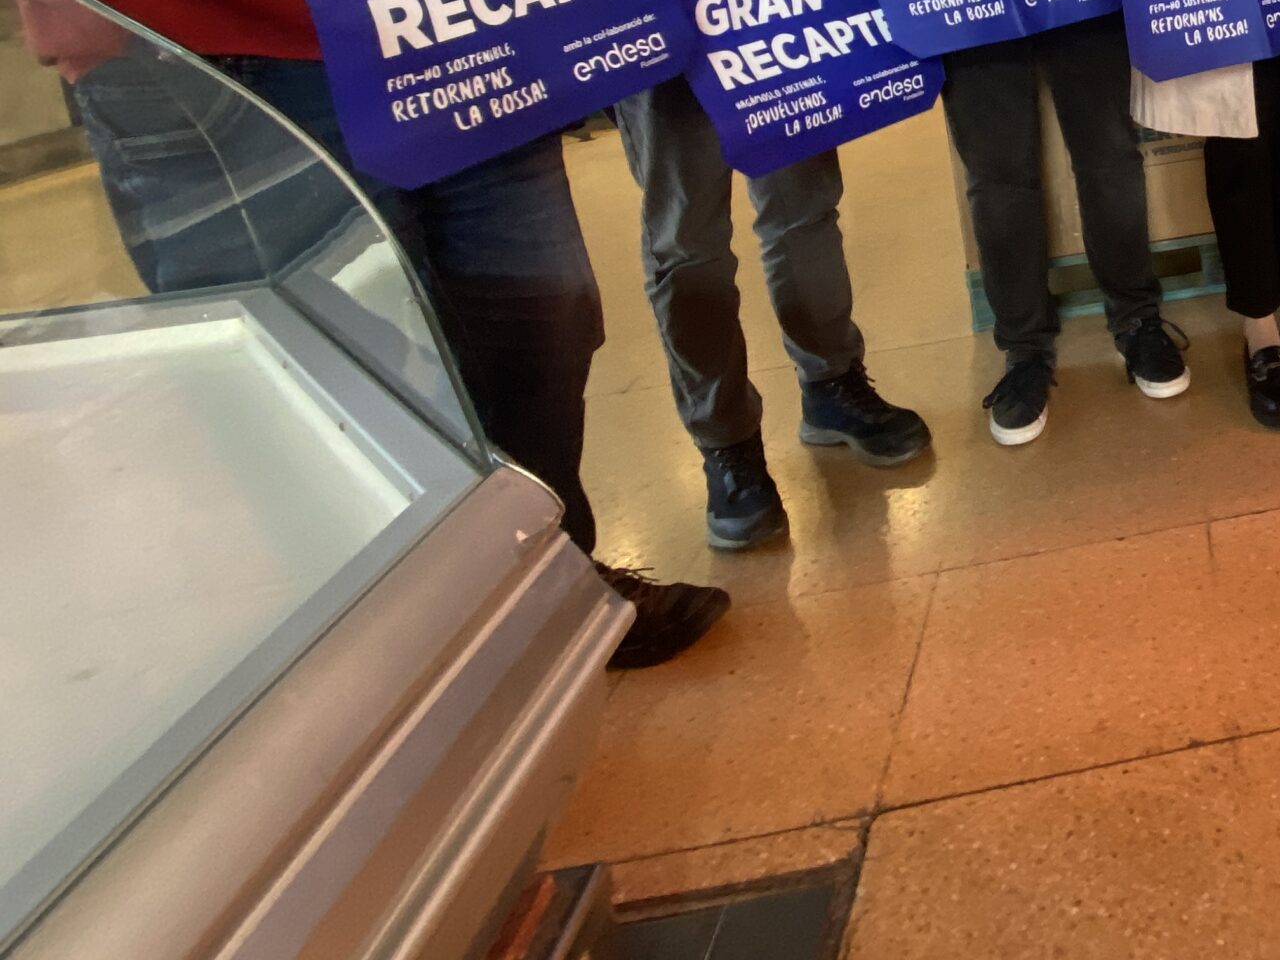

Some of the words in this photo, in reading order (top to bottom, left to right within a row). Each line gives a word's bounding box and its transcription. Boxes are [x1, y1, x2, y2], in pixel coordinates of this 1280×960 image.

[944, 12, 961, 25] LA
[967, 0, 1004, 21] BOSSA!
[1151, 7, 1224, 34] RETORNA'NS
[1185, 32, 1201, 46] LA
[1207, 19, 1248, 41] BOSSA!
[574, 32, 666, 81] endesa
[392, 67, 513, 122] RETORNA'NS
[454, 106, 482, 130] LA
[490, 79, 548, 118] BOSSA!
[859, 74, 924, 109] endesa
[785, 123, 800, 137] LA
[806, 104, 842, 130] BOLSA!
